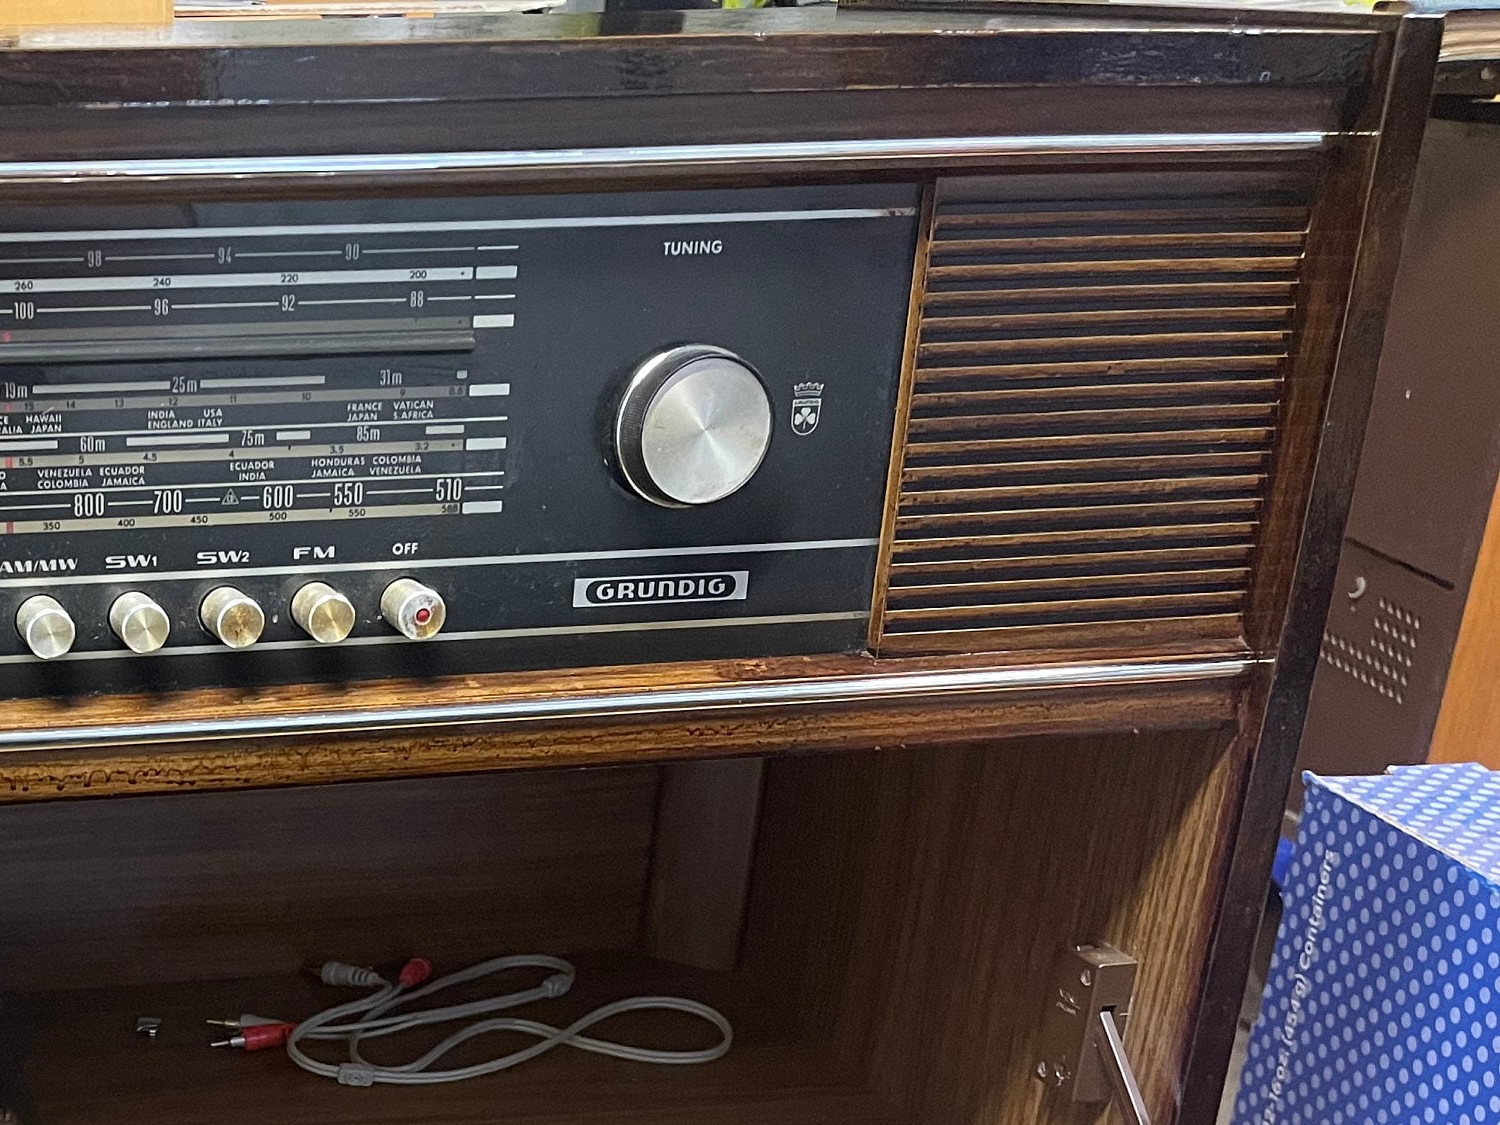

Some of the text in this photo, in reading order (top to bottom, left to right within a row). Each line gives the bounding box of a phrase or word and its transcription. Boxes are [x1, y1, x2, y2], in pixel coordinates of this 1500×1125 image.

[87, 250, 101, 267] 98
[218, 247, 232, 264] 94
[345, 243, 359, 261] 90
[663, 240, 723, 256] TUNING
[14, 280, 33, 291] 260
[153, 277, 171, 287] 240
[280, 273, 299, 283] 220
[410, 270, 427, 280] 200
[14, 302, 34, 320] 100
[154, 298, 169, 316] 96
[281, 295, 295, 312] 92
[410, 290, 424, 308] 88
[4, 382, 28, 399] 19m
[172, 376, 197, 393] 25m
[379, 369, 402, 386] 31m
[24, 402, 34, 411] 15
[66, 400, 76, 409] 14
[302, 392, 311, 401] 10
[26, 414, 62, 424] HAWAII
[147, 410, 175, 420] INDIA
[203, 408, 223, 418] USA
[347, 402, 382, 412] FRANCE
[393, 400, 434, 410] VATICAN
[30, 424, 62, 434] JAPAN
[147, 420, 194, 429] ENGLAND
[198, 418, 223, 427] ITALY
[346, 412, 377, 422] JAPAN
[80, 436, 106, 452] 60m
[241, 430, 265, 446] 75m
[356, 425, 380, 441] 85m
[19, 457, 33, 466] 5.5
[79, 456, 84, 464] 5
[143, 453, 157, 462] 4.5
[228, 450, 234, 458] 4
[37, 468, 93, 478] VENEZUELA
[100, 466, 145, 476] ECUADOR
[230, 460, 275, 471] ECUADOR
[311, 456, 365, 467] HONDURAS
[372, 454, 422, 465] COLOMBIA
[37, 478, 89, 489] COLOMBIA
[101, 476, 146, 487] JAMAICA
[238, 472, 266, 481] INDIA
[311, 467, 355, 478] JAMAICA
[369, 465, 422, 476] VENEZUELA
[74, 493, 105, 517] 800
[153, 489, 183, 514] 700
[263, 485, 294, 509] 600
[334, 482, 364, 506] 550
[436, 478, 462, 501] 510
[43, 521, 61, 531] 350
[117, 518, 135, 528] 400
[190, 515, 208, 524] 450
[269, 512, 287, 521] 500
[348, 508, 366, 517] 550
[197, 550, 250, 565] SW2
[293, 545, 335, 560] FM
[392, 542, 418, 555] OFF
[0, 558, 78, 574] AM/MW
[105, 554, 157, 569] SW1
[596, 577, 726, 600] GRUNDIG
[1300, 849, 1334, 970] Containers
